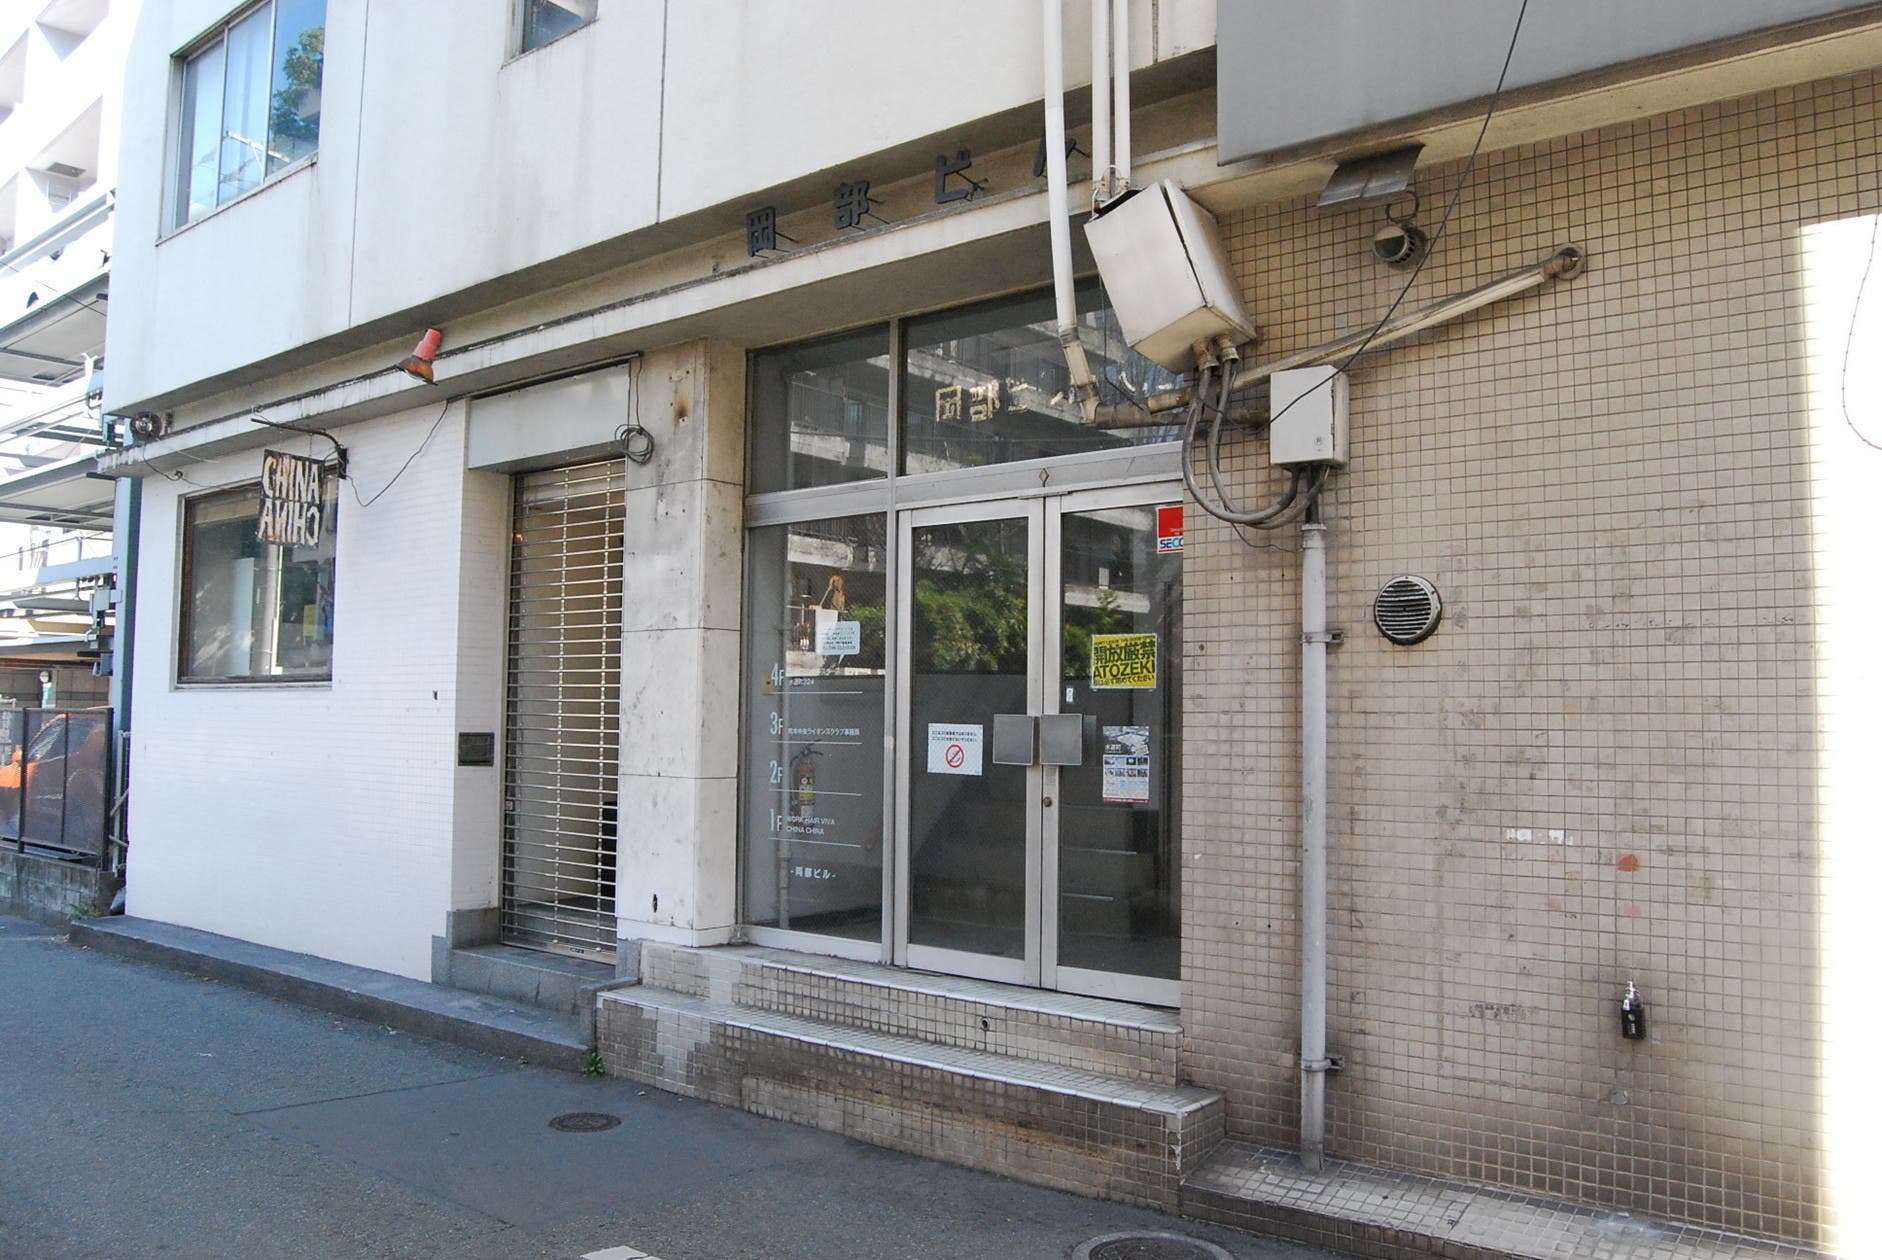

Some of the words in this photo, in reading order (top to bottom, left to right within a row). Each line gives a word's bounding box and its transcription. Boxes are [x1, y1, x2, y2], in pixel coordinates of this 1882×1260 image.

[262, 455, 320, 505] CHINA
[771, 663, 784, 686] 4F
[1094, 660, 1155, 680] ATOZEKI
[770, 712, 783, 735] 3F
[770, 760, 783, 784] 2F
[769, 808, 782, 832] 1F
